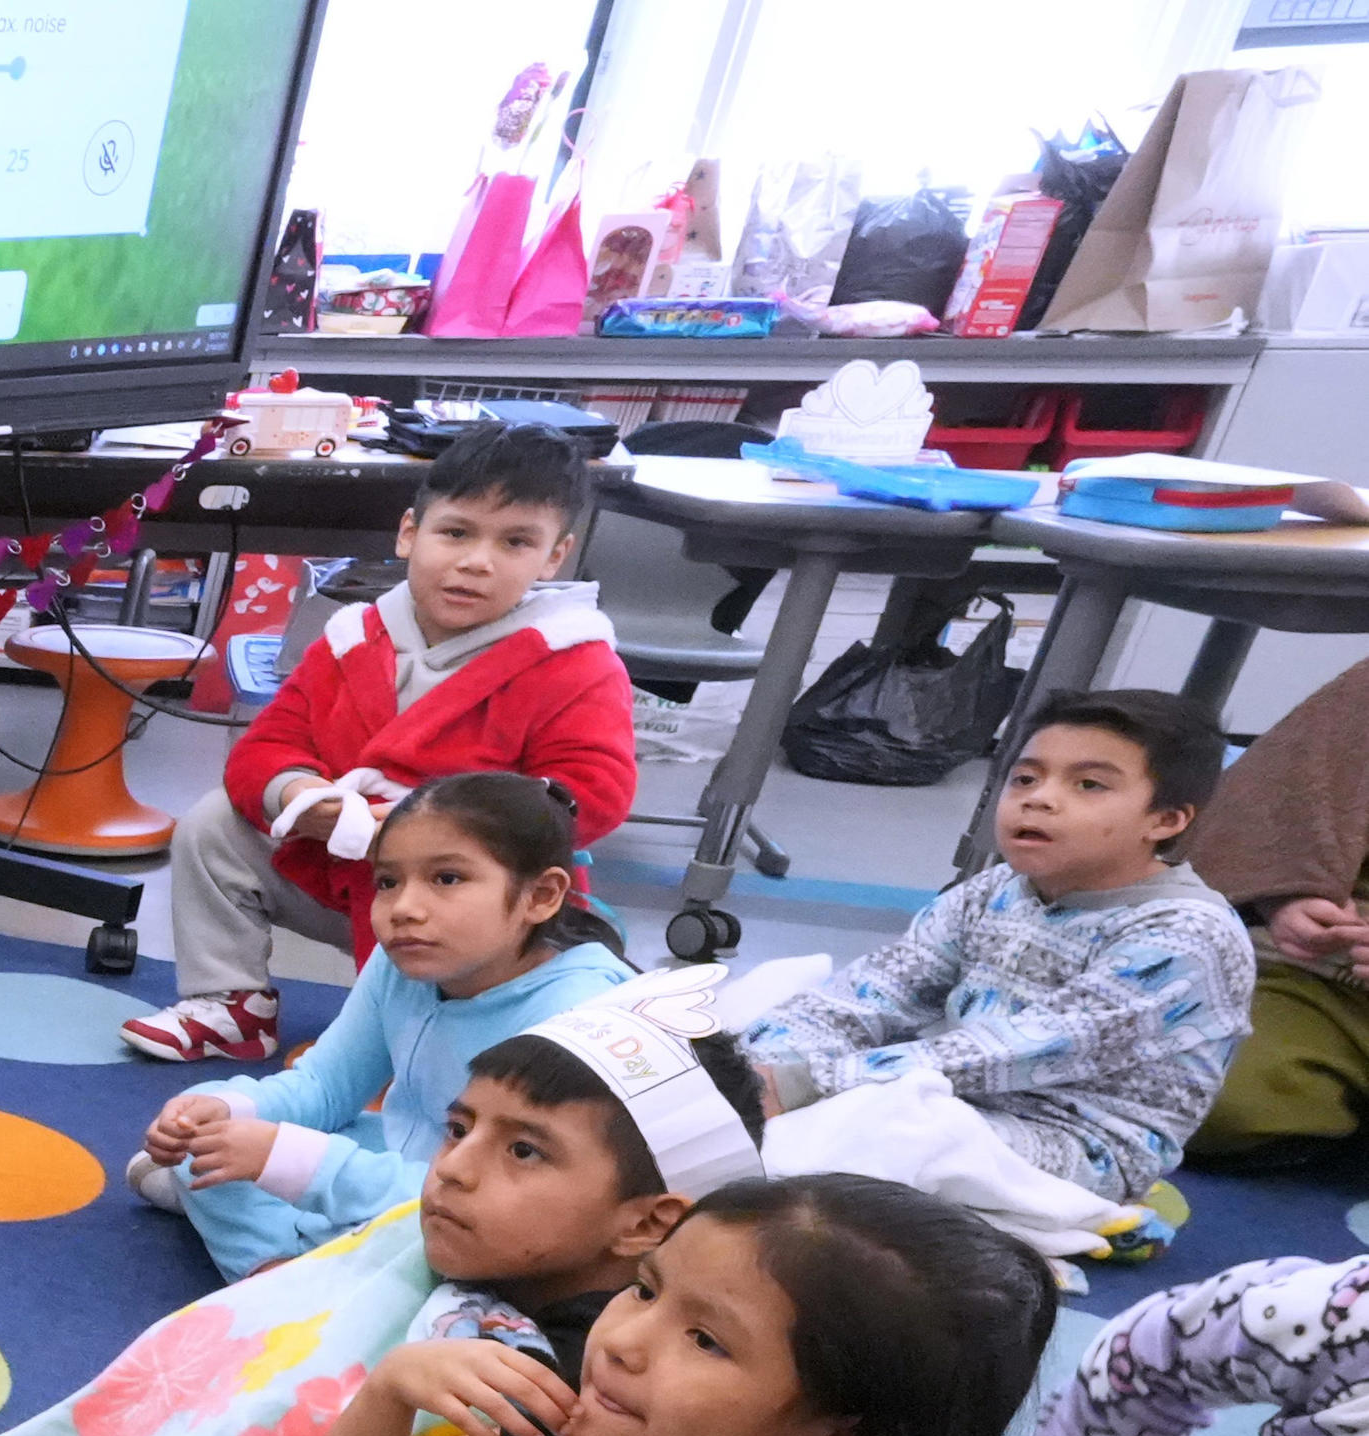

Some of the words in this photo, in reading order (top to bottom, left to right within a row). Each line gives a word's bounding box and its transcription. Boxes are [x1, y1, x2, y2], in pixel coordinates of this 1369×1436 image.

[24, 14, 67, 34] noise
[5, 148, 31, 173] 25
[606, 1035, 659, 1081] Day
